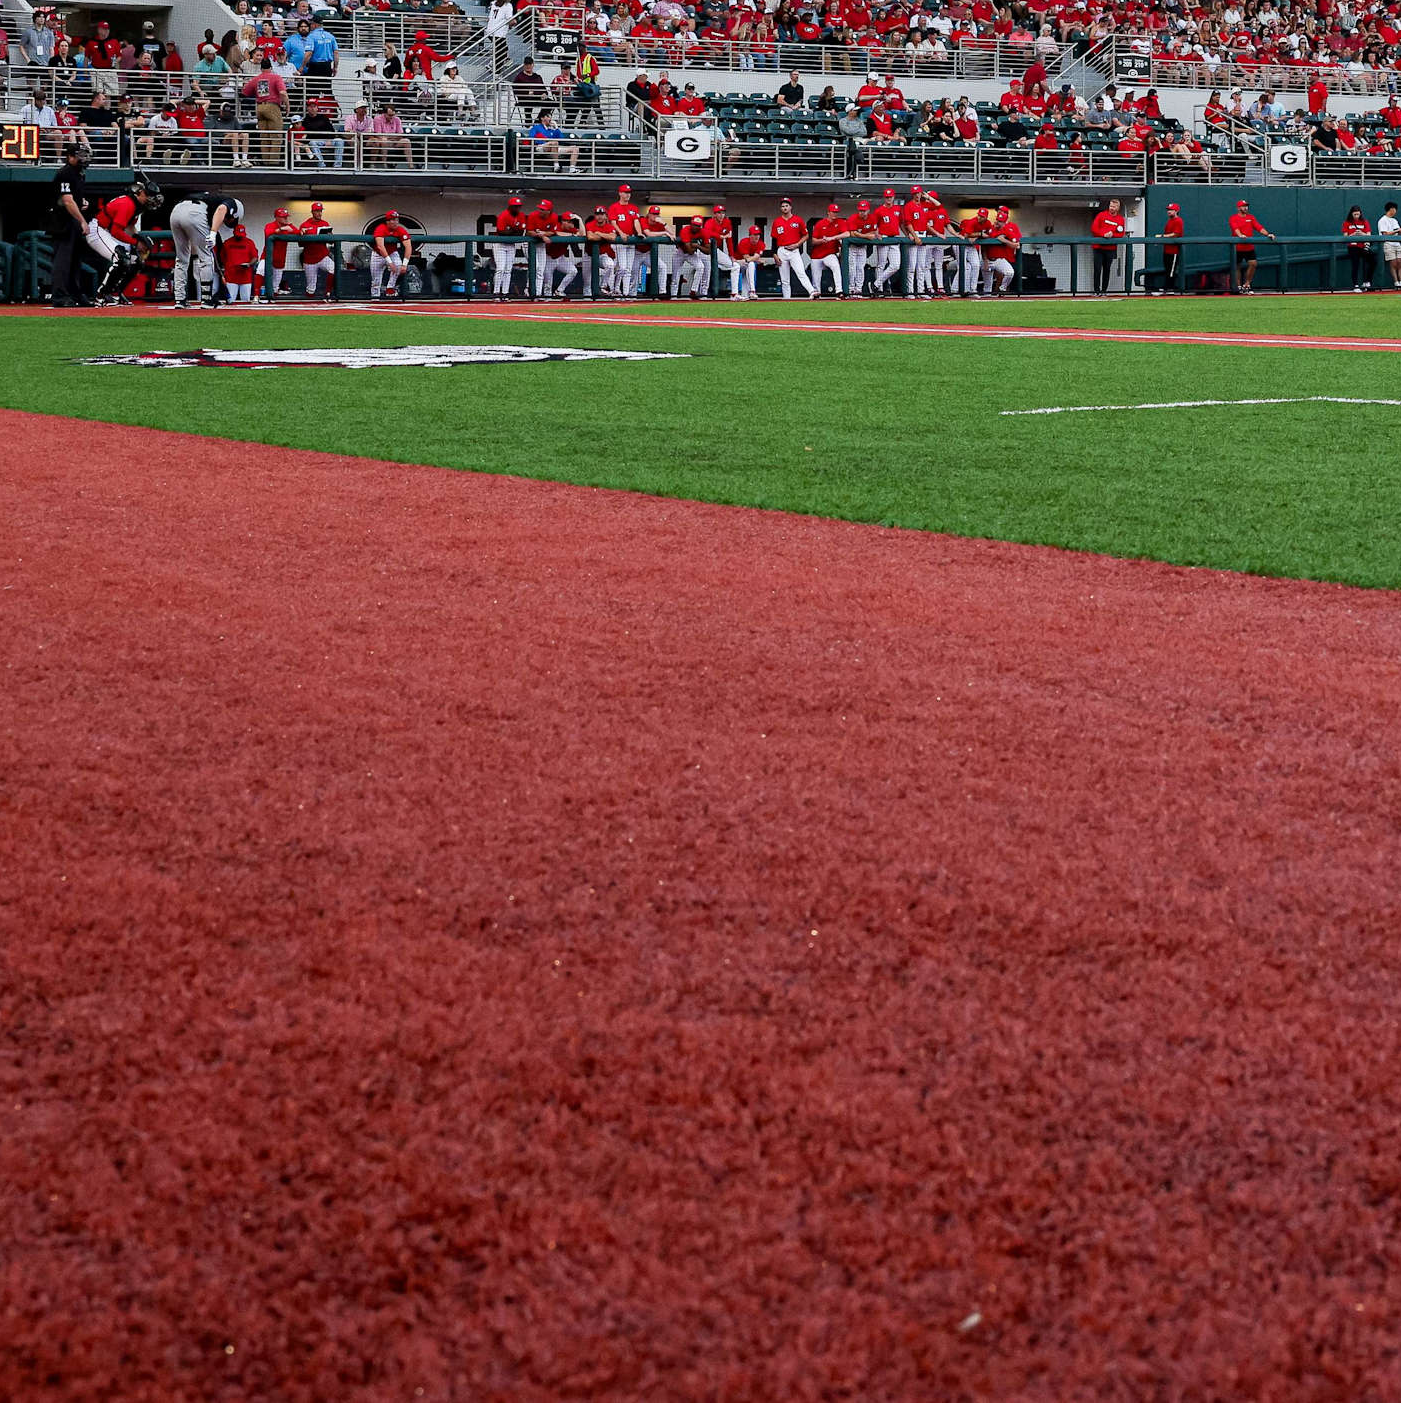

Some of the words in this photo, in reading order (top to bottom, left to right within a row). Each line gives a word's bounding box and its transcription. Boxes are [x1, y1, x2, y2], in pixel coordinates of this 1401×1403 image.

[1, 125, 38, 159] 20
[676, 137, 699, 152] G
[1280, 152, 1297, 165] G
